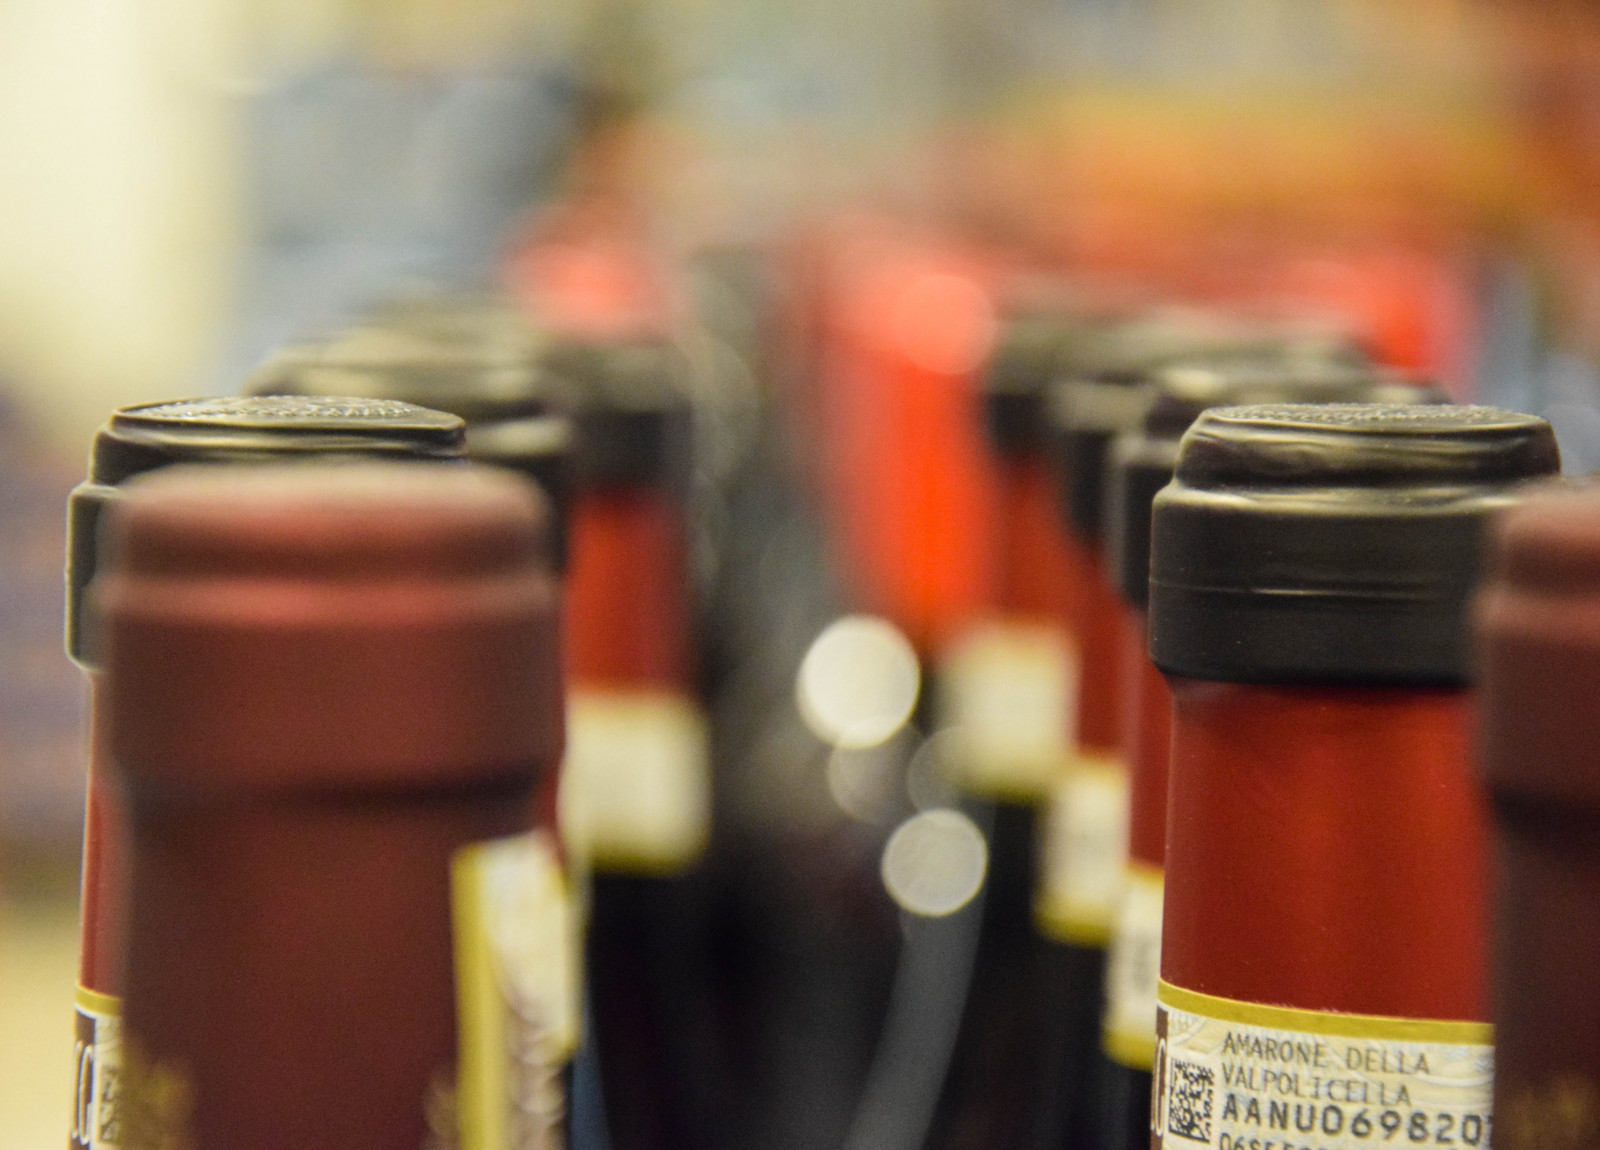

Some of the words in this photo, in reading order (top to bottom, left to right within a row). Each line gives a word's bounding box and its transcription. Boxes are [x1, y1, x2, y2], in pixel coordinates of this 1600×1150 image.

[1222, 1031, 1328, 1068] AMARONE
[1346, 1046, 1430, 1075] DELLA
[1222, 1062, 1413, 1107] VALPOLICELLA
